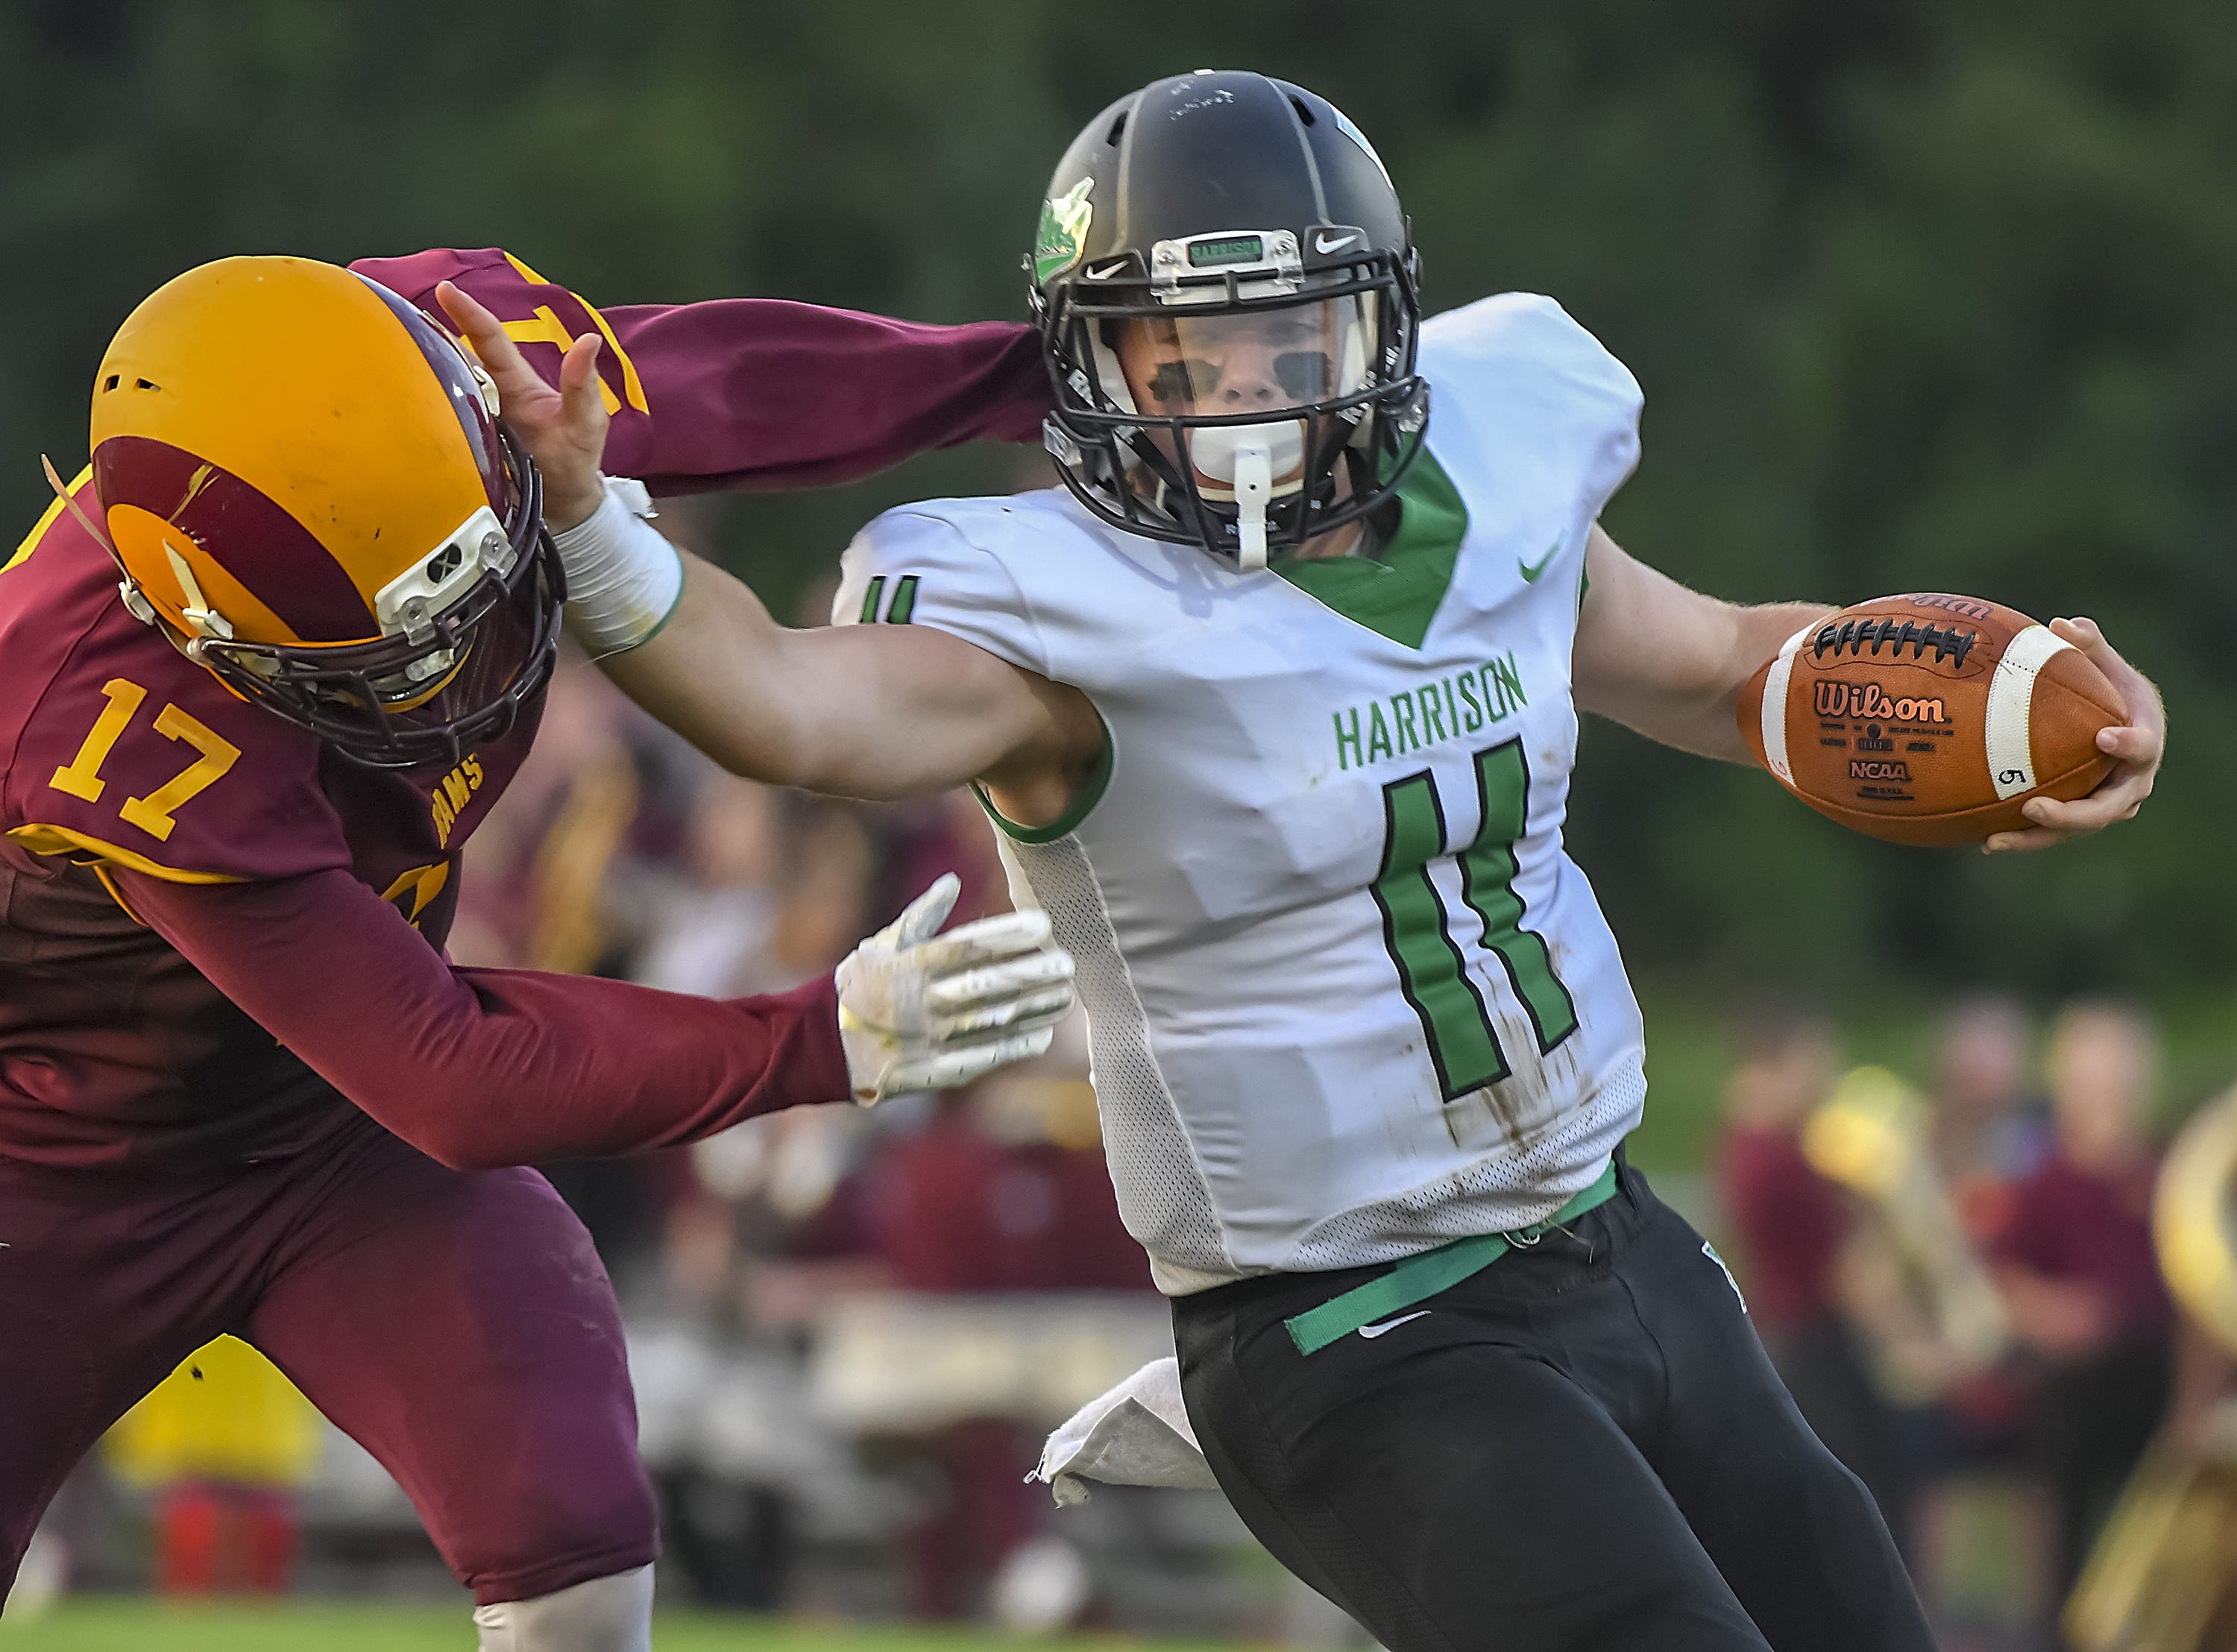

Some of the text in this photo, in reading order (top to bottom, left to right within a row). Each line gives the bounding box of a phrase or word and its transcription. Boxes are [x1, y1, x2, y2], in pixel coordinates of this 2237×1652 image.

[49, 678, 242, 842] 17
[1333, 649, 1527, 771] HARRISON
[1815, 680, 1945, 723] Wilson
[1850, 760, 1911, 781] NCAA
[1369, 734, 1581, 1104] 11
